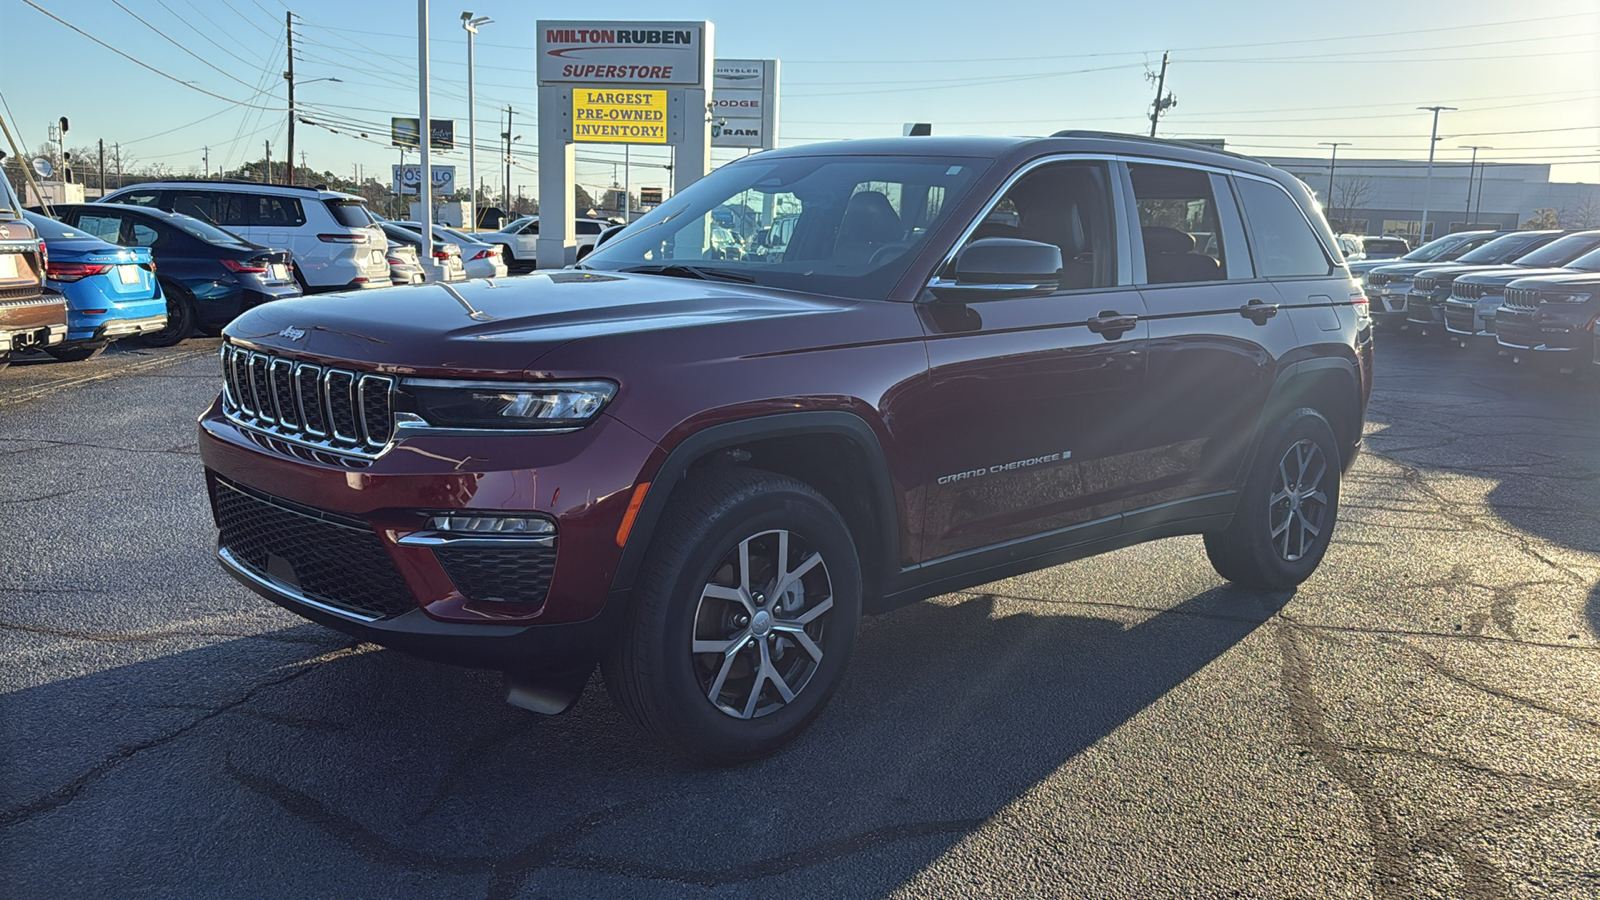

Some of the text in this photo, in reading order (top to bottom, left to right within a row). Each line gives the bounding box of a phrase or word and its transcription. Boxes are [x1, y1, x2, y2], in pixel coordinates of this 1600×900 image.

[562, 64, 673, 78] SUPERSTORE
[587, 93, 652, 105] LARGEST
[576, 108, 663, 121] PRE-OWNED
[575, 124, 664, 138] INVENTORY!
[723, 128, 758, 136] RAM
[395, 170, 452, 182] OSILO
[279, 324, 306, 342] Jeep
[937, 453, 1060, 485] GRAND CHEROKEE
